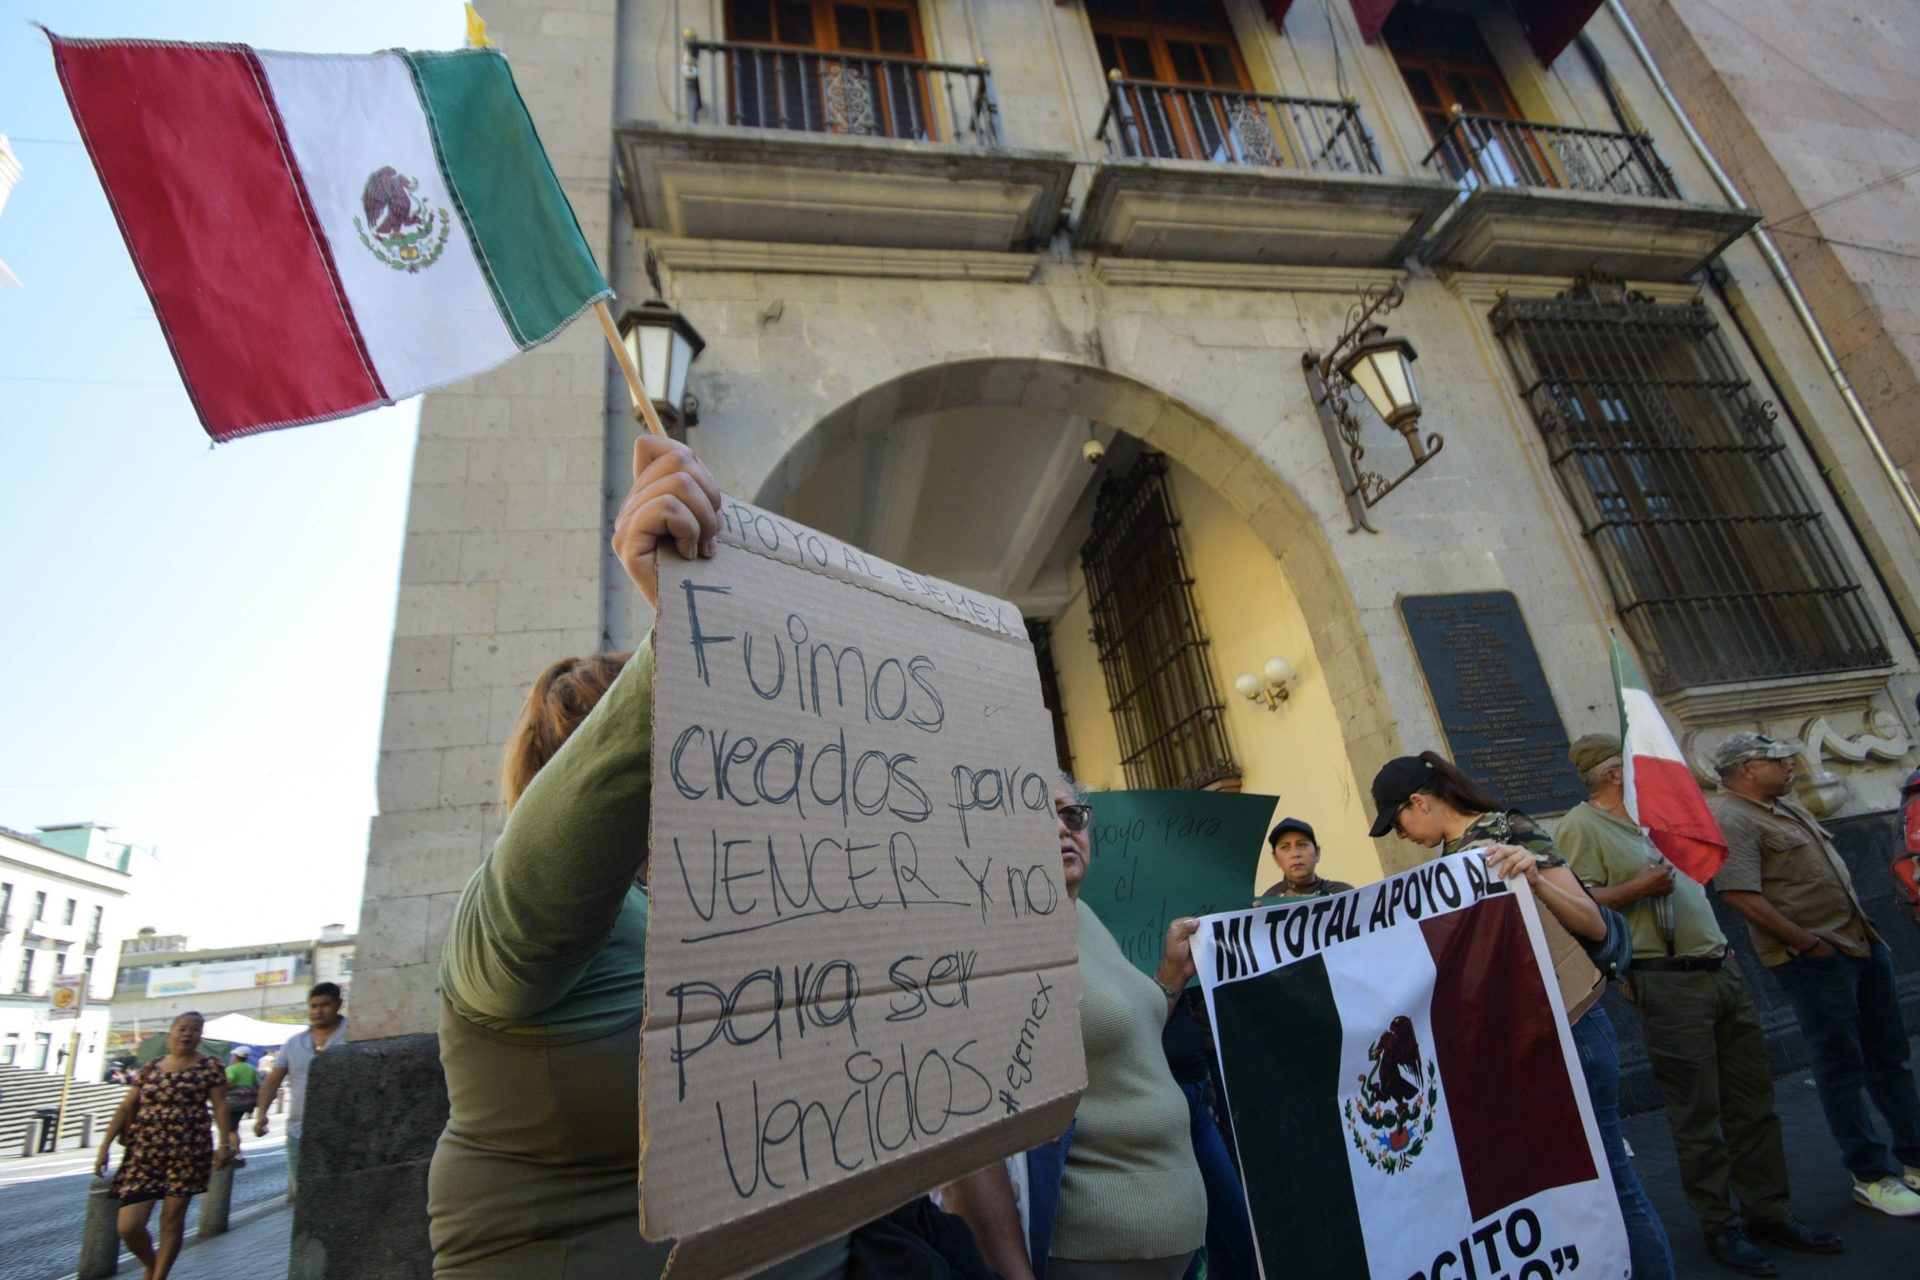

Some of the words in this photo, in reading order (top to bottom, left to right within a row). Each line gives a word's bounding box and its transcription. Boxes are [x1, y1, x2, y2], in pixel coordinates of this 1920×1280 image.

[843, 546, 882, 579] AL
[896, 568, 1012, 637] EJEMEX
[669, 724, 934, 828] creados
[949, 765, 1055, 848] para
[673, 829, 940, 922] VENCER
[1093, 818, 1145, 860] poyo
[1114, 856, 1137, 901] el
[1212, 915, 1259, 982] MI
[1265, 893, 1360, 964] TOTAL
[1369, 862, 1460, 932] APOYO
[1462, 853, 1507, 901] AL
[666, 960, 861, 1100] para
[885, 950, 978, 1021] ser
[1407, 1208, 1542, 1280] CITO
